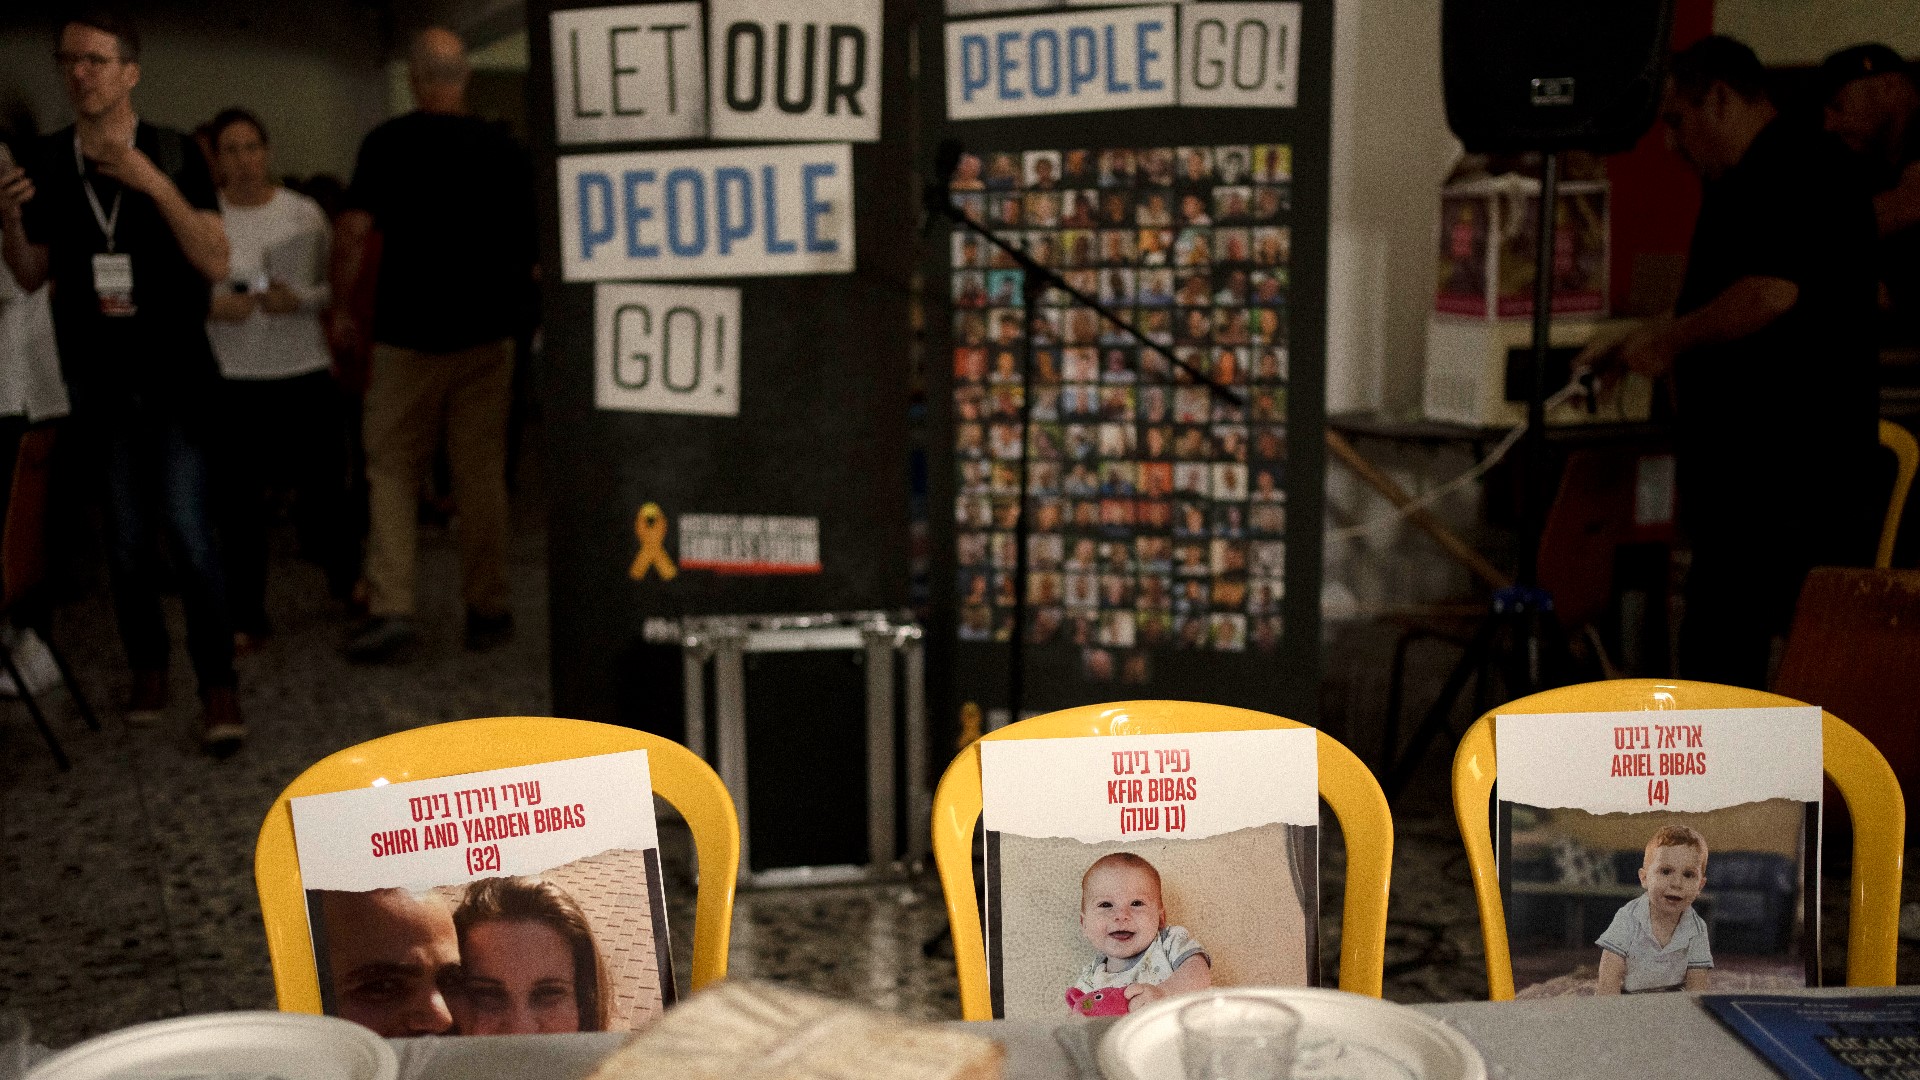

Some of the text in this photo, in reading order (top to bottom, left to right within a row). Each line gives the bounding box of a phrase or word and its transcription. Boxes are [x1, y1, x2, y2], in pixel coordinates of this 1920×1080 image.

[570, 20, 866, 119] LET OUR
[961, 18, 1288, 102] PEOPLE GO!
[577, 162, 839, 261] PEOPLE
[612, 302, 725, 397] GO!
[1613, 724, 1704, 750] אריאל ביבס
[1111, 748, 1191, 775] כפיר ביבס
[1611, 751, 1707, 777] ARIEL BIBAS
[408, 780, 542, 822] שירי וירדן ביבס
[1107, 776, 1197, 804] KFIR BIBAS
[1647, 778, 1670, 806] (4)
[370, 803, 586, 858] SHIRI AND YARDEN BIBAS
[1120, 804, 1186, 834] (בן שנה)
[465, 843, 501, 876] (32)
